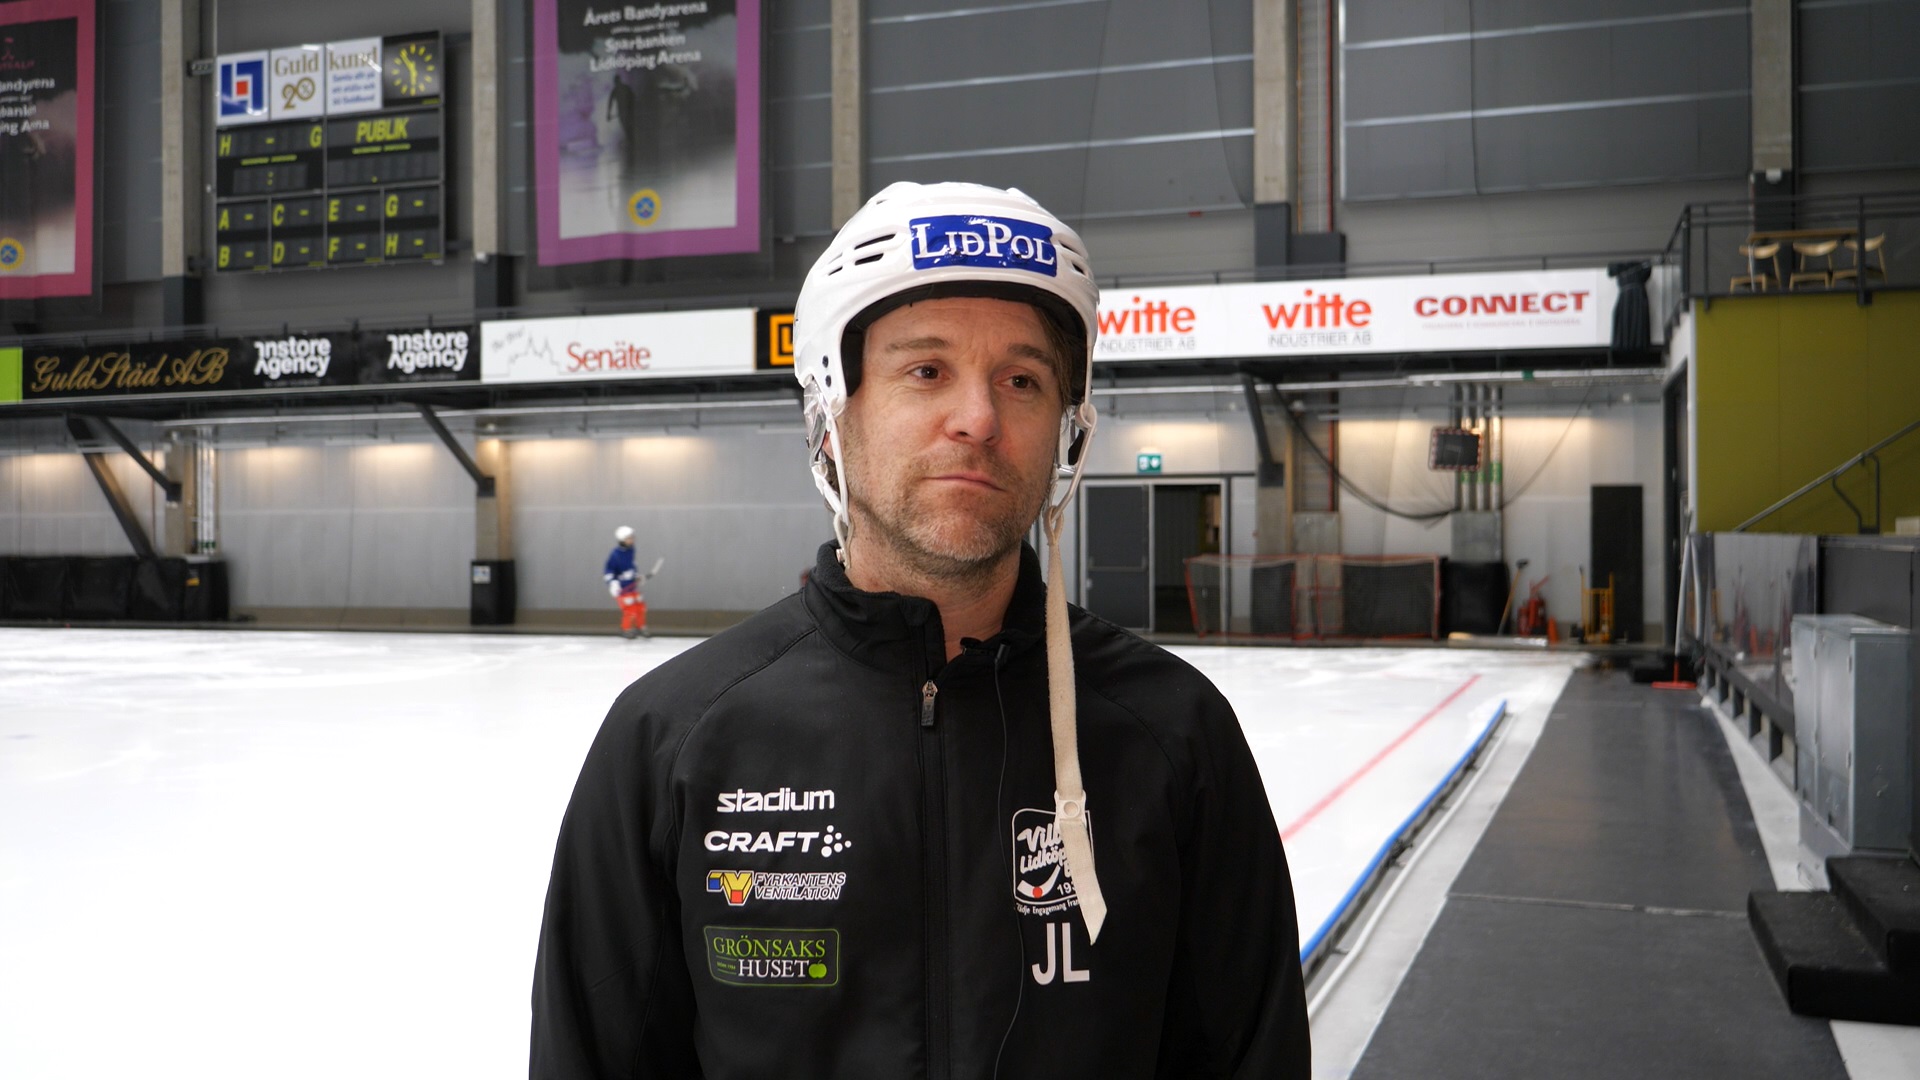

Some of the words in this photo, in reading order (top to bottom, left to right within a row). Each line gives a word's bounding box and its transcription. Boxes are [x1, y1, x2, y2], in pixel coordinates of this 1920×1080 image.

[624, 1, 708, 20] Bandyarena
[604, 32, 686, 53] Sparbanken
[274, 53, 319, 77] Guld
[329, 45, 377, 70] kund
[657, 50, 702, 65] Arena
[219, 134, 231, 157] H
[309, 124, 323, 148] G
[355, 117, 409, 144] PUBLIK
[218, 208, 230, 231] A
[272, 203, 285, 227] C
[328, 199, 340, 222] E
[385, 194, 399, 218] G
[218, 245, 230, 268] B
[272, 241, 285, 264] D
[328, 237, 340, 260] F
[385, 233, 399, 256] H
[1097, 296, 1196, 335] witte
[1262, 289, 1372, 329] witte
[1414, 290, 1590, 318] CONNECT
[1352, 330, 1373, 346] AB
[164, 347, 229, 385] AB
[254, 355, 331, 380] Agency
[387, 349, 469, 374] Agency
[566, 341, 651, 372] Senäte
[717, 787, 835, 813] stadium
[704, 831, 820, 853] CRAFT
[754, 872, 846, 886] FYRKANTENS
[755, 886, 841, 899] VENTILATION
[713, 935, 826, 958] GRÖNSAKS
[1032, 923, 1090, 985] JL
[738, 959, 810, 978] HUSET
